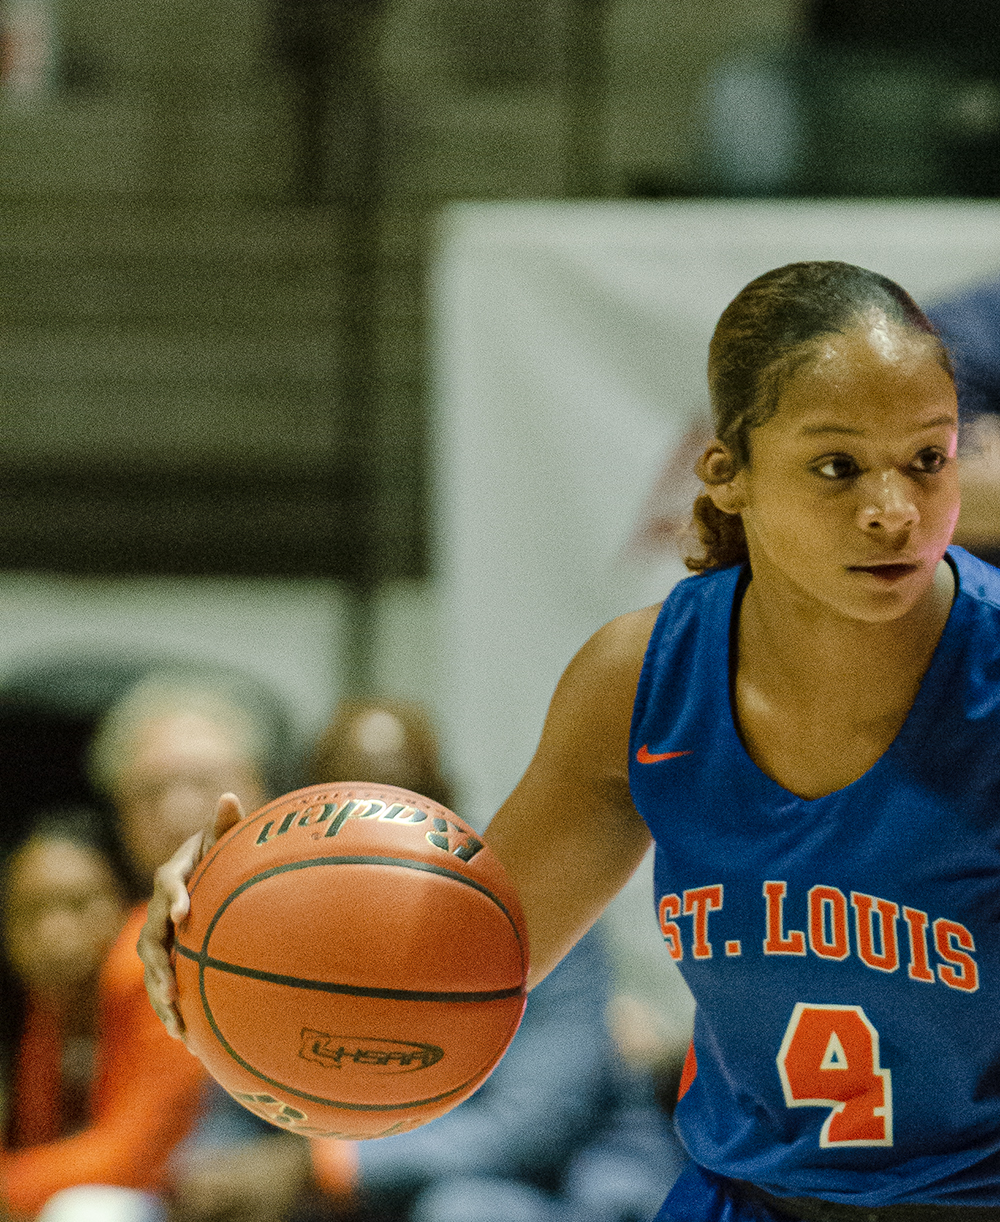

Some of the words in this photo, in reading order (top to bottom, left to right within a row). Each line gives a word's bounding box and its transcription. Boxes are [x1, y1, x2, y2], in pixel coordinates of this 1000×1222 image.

[255, 799, 485, 864] Baden
[658, 883, 742, 961] ST.
[763, 880, 980, 993] LOUIS
[776, 1002, 894, 1149] 4
